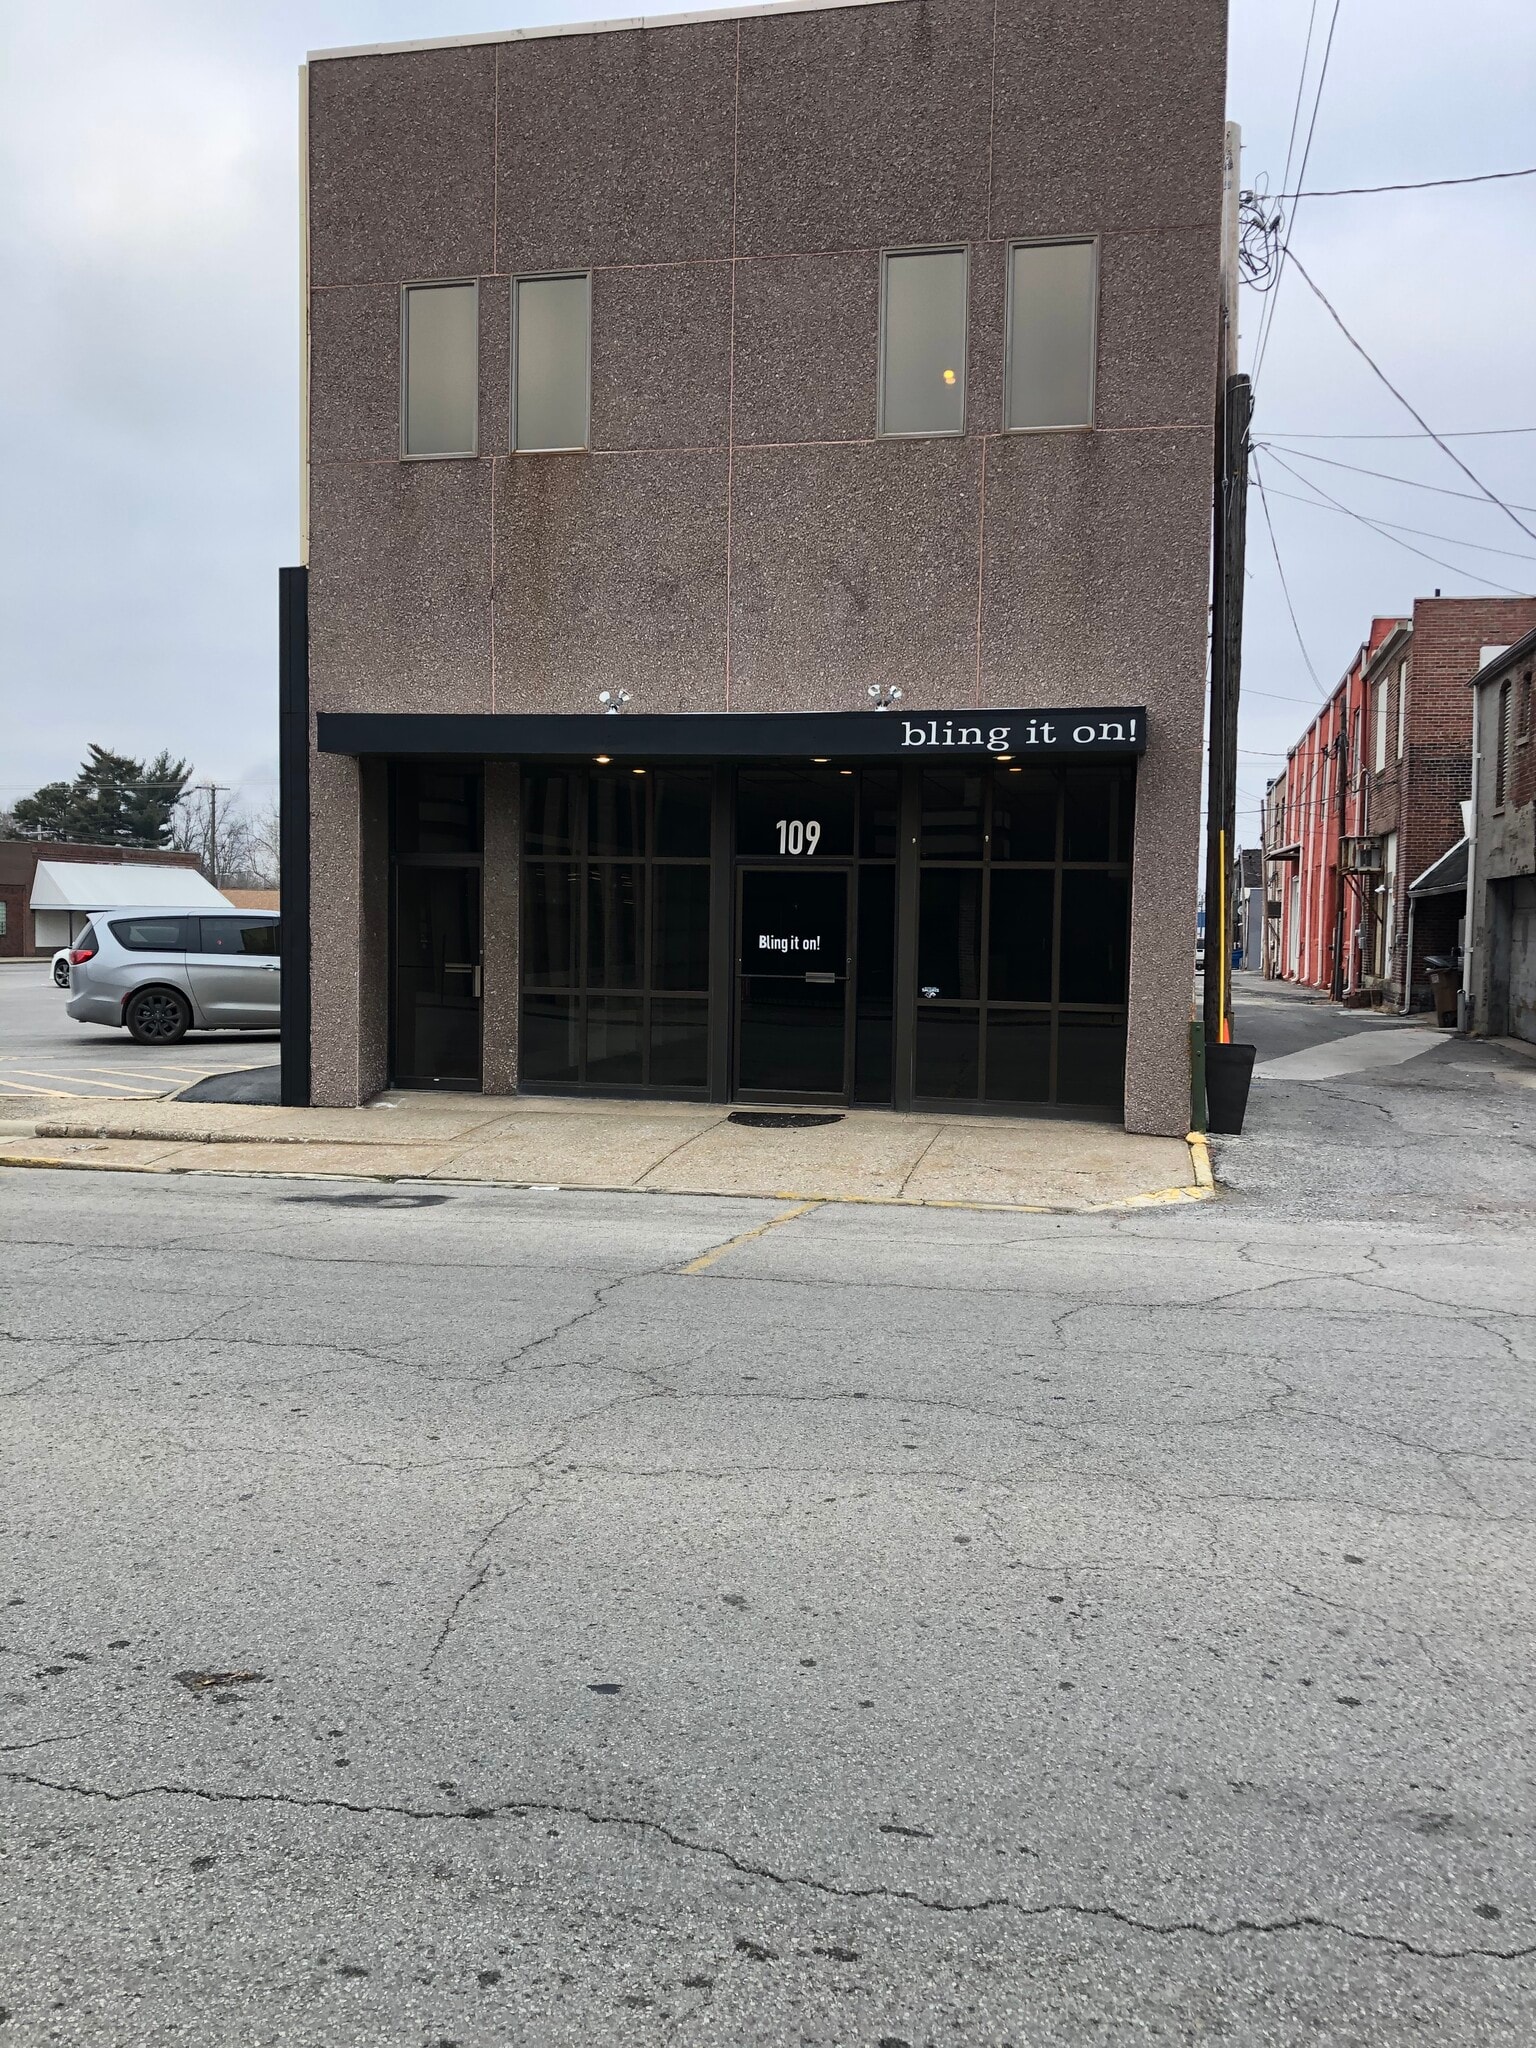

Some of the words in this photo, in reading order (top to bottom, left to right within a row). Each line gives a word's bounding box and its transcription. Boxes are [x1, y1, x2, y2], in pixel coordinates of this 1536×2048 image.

[901, 720, 1011, 752] bling
[1025, 718, 1057, 744] it
[1072, 718, 1137, 744] on!
[776, 819, 821, 855] 109
[758, 934, 788, 953] Bling
[790, 936, 800, 950] it
[802, 935, 821, 951] on!
